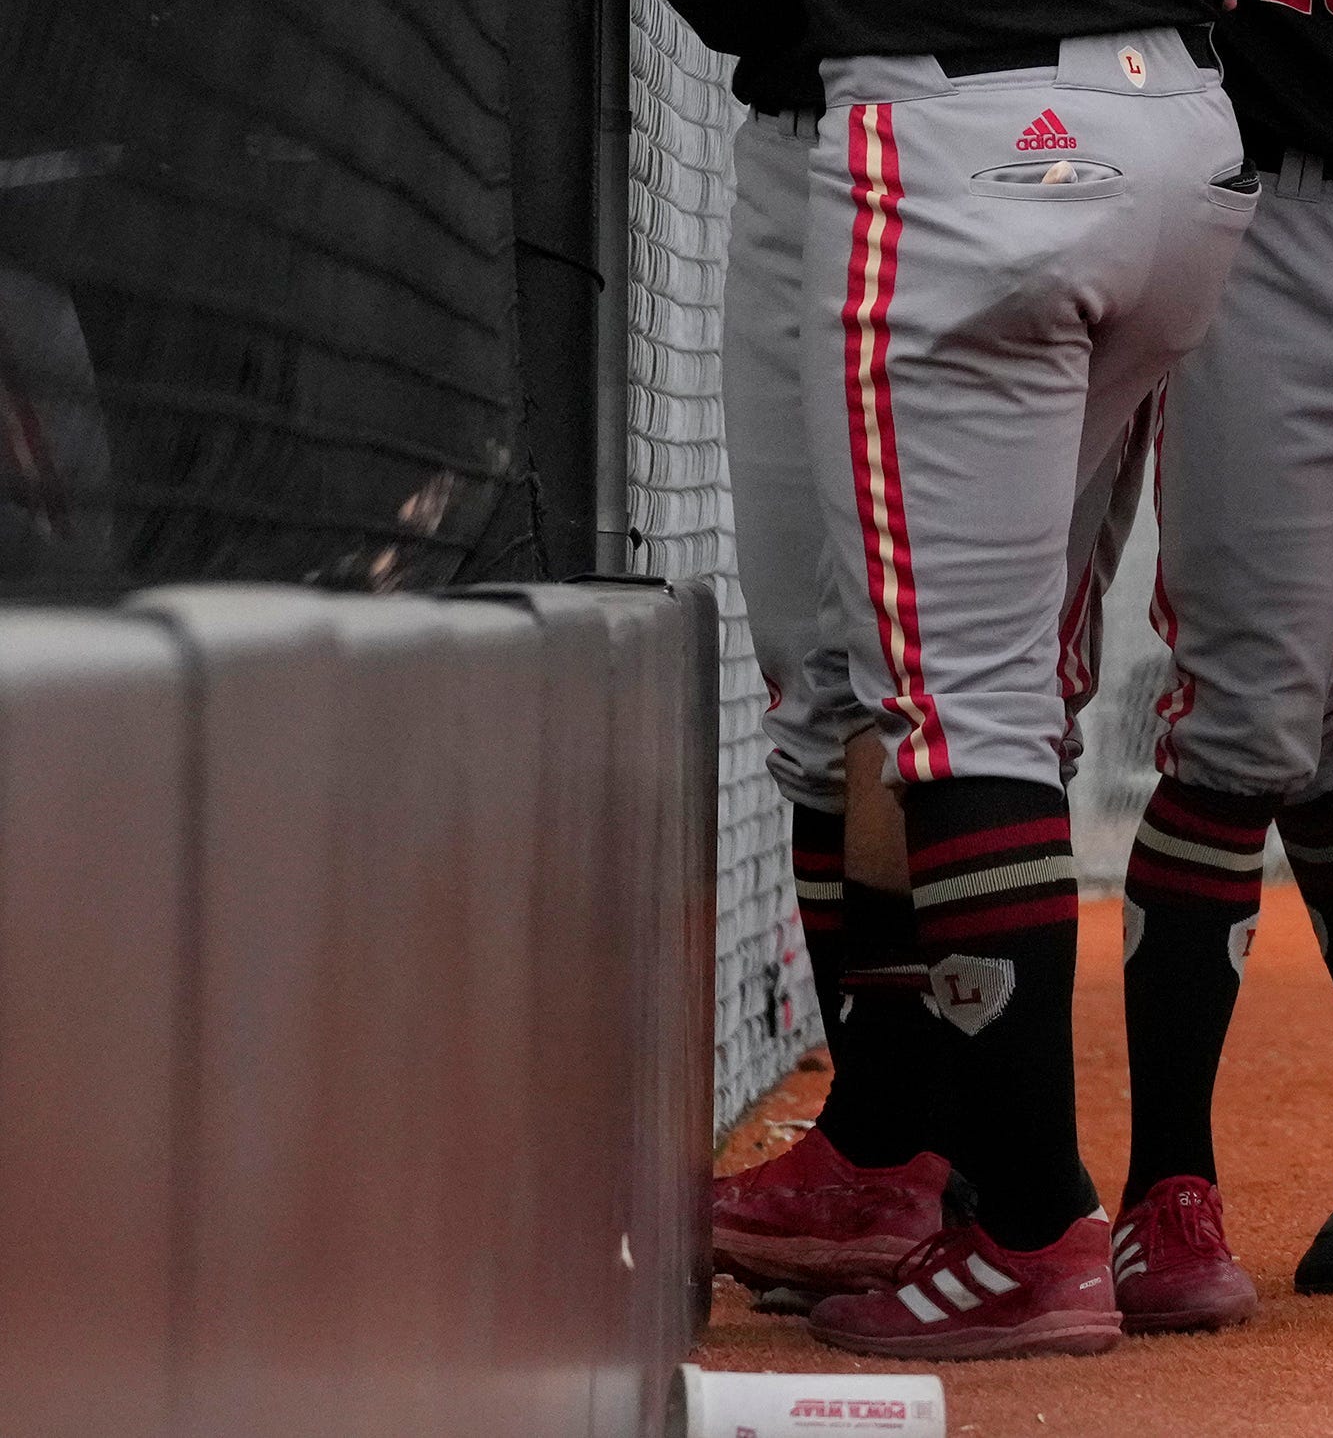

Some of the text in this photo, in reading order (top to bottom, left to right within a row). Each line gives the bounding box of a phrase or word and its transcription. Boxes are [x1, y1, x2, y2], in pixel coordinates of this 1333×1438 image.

[1126, 56, 1141, 74] L
[1016, 133, 1077, 151] adidas
[945, 974, 981, 1005] L
